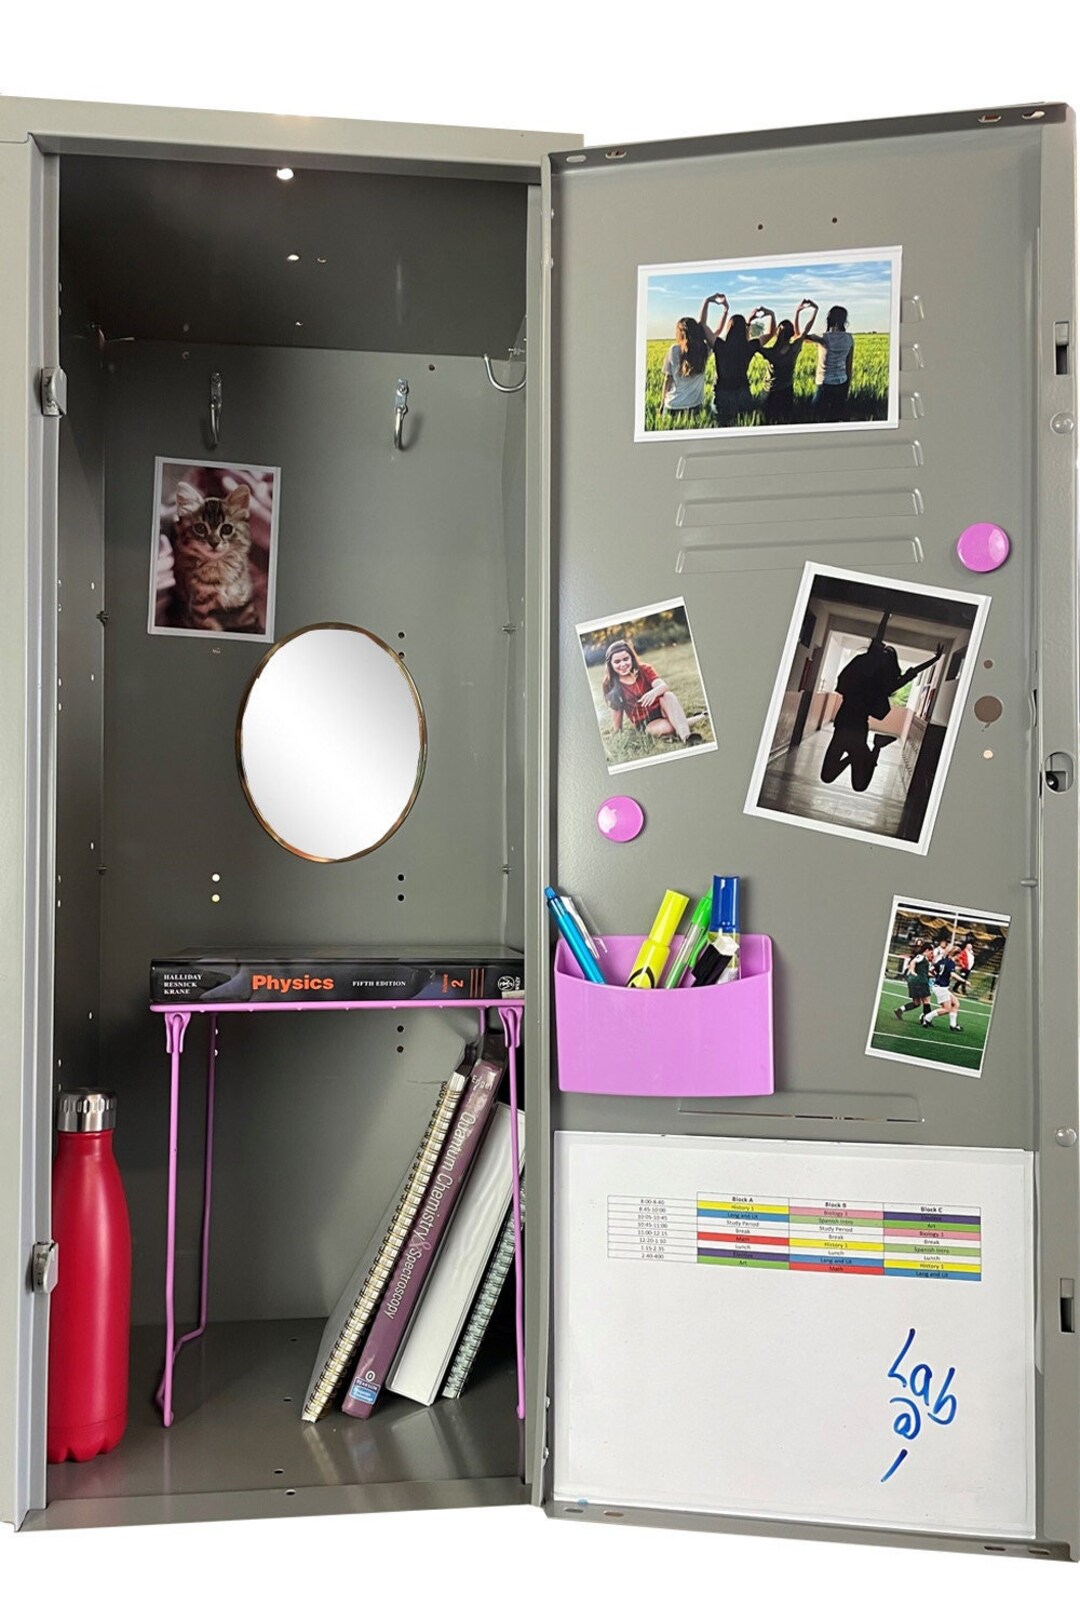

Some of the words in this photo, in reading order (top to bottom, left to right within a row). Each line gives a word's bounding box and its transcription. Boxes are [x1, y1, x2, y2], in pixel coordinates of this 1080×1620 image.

[252, 974, 334, 992] Physics
[451, 979, 463, 988] 2
[442, 1111, 477, 1172] Quantum
[414, 1173, 453, 1243] Chemistry
[384, 1248, 422, 1319] Spectroscopy
[888, 1328, 957, 1425] Lab
[890, 1397, 921, 1440] @
